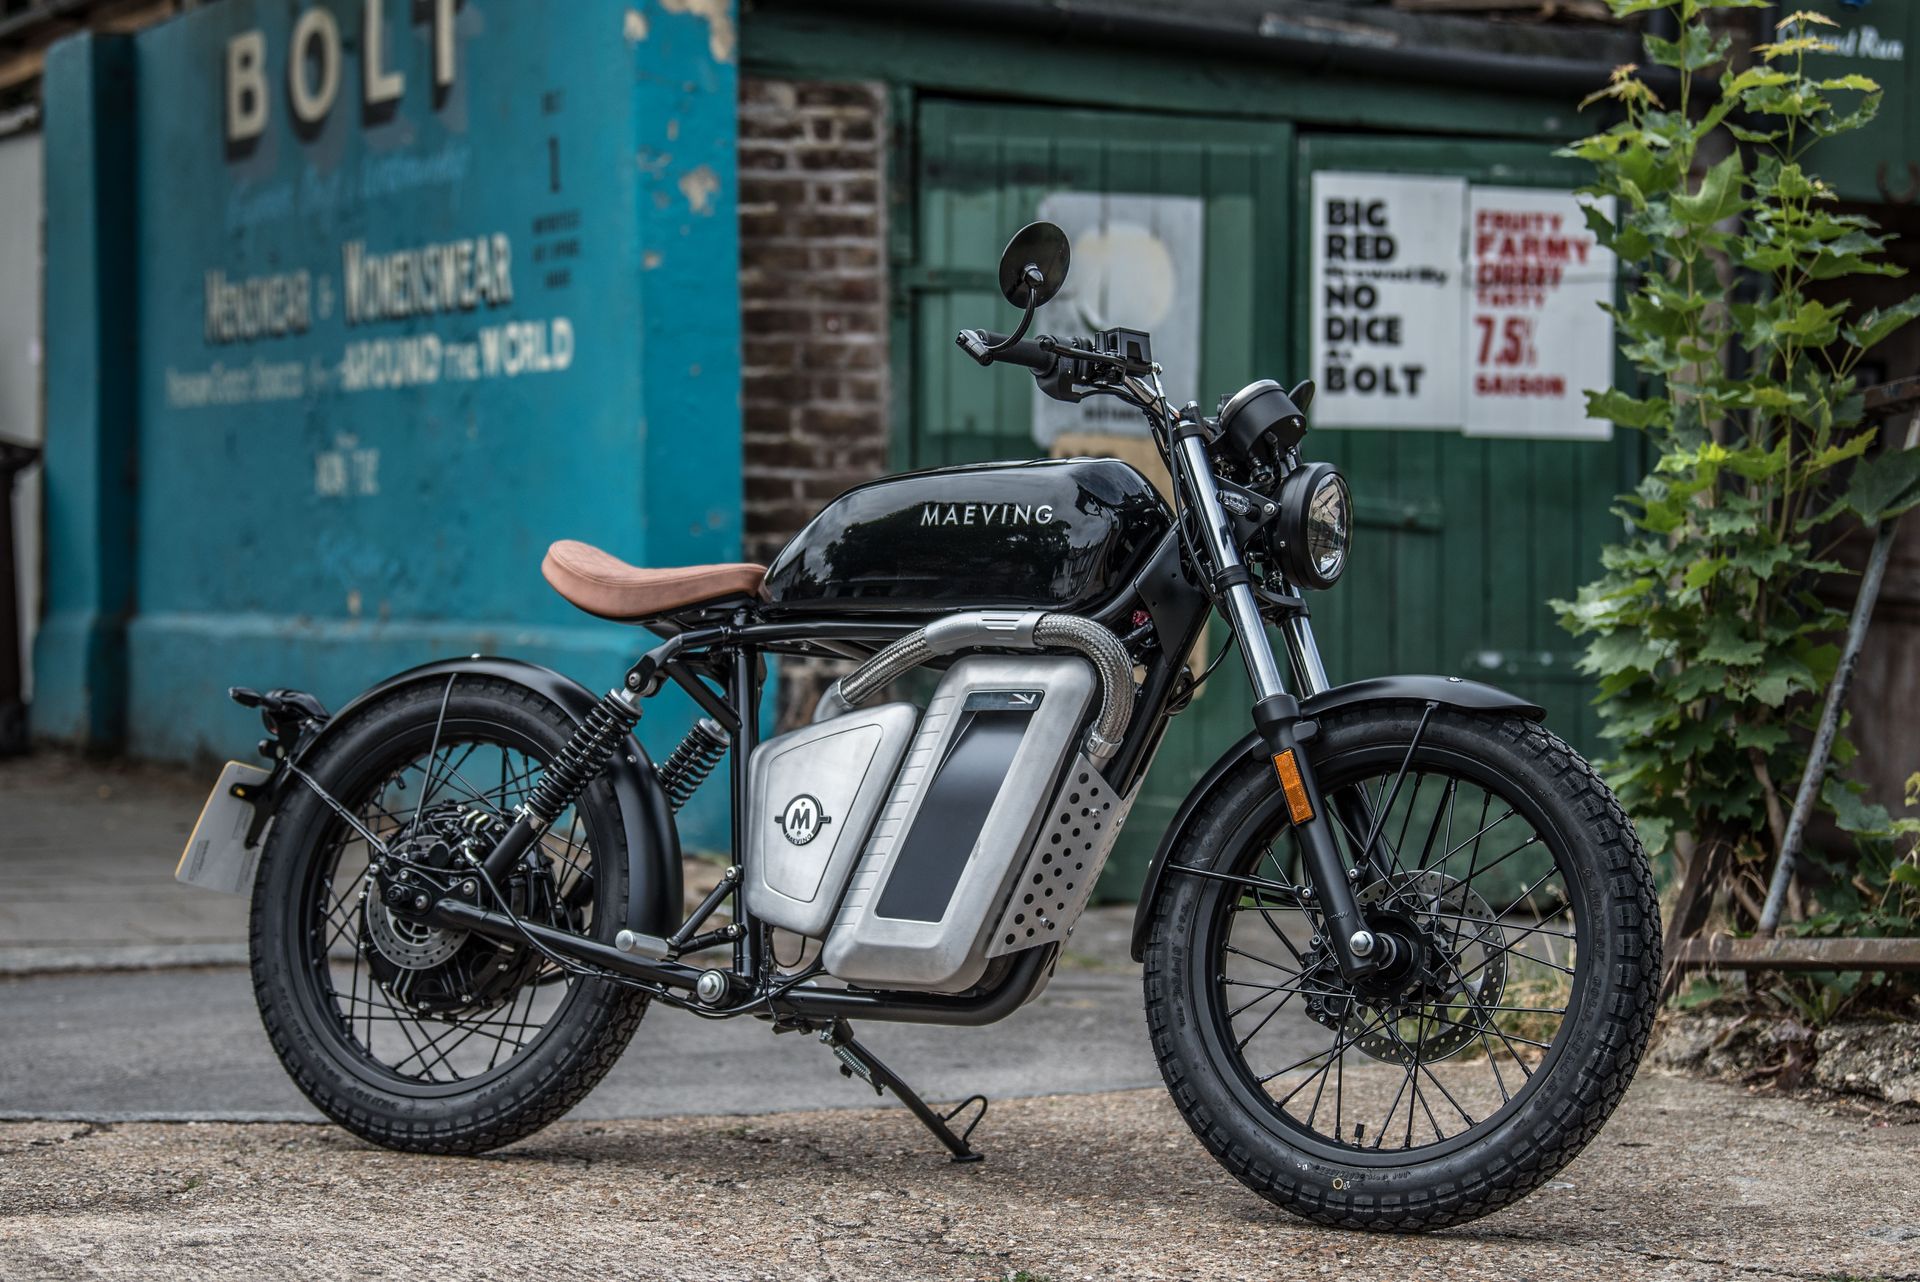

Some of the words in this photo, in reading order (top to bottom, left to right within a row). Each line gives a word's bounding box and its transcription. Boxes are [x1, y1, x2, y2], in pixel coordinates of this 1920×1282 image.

[227, 0, 456, 141] BOLT
[1327, 199, 1387, 227] BIG
[1327, 233, 1395, 261] RED
[1327, 284, 1377, 309] NO
[1327, 317, 1401, 345] DICE
[342, 331, 443, 391] AROUND
[480, 317, 574, 377] WORLD
[1327, 366, 1425, 396] BOLT
[920, 504, 1053, 527] MAEVING
[790, 808, 811, 830] M
[784, 832, 814, 845] MAEVING
